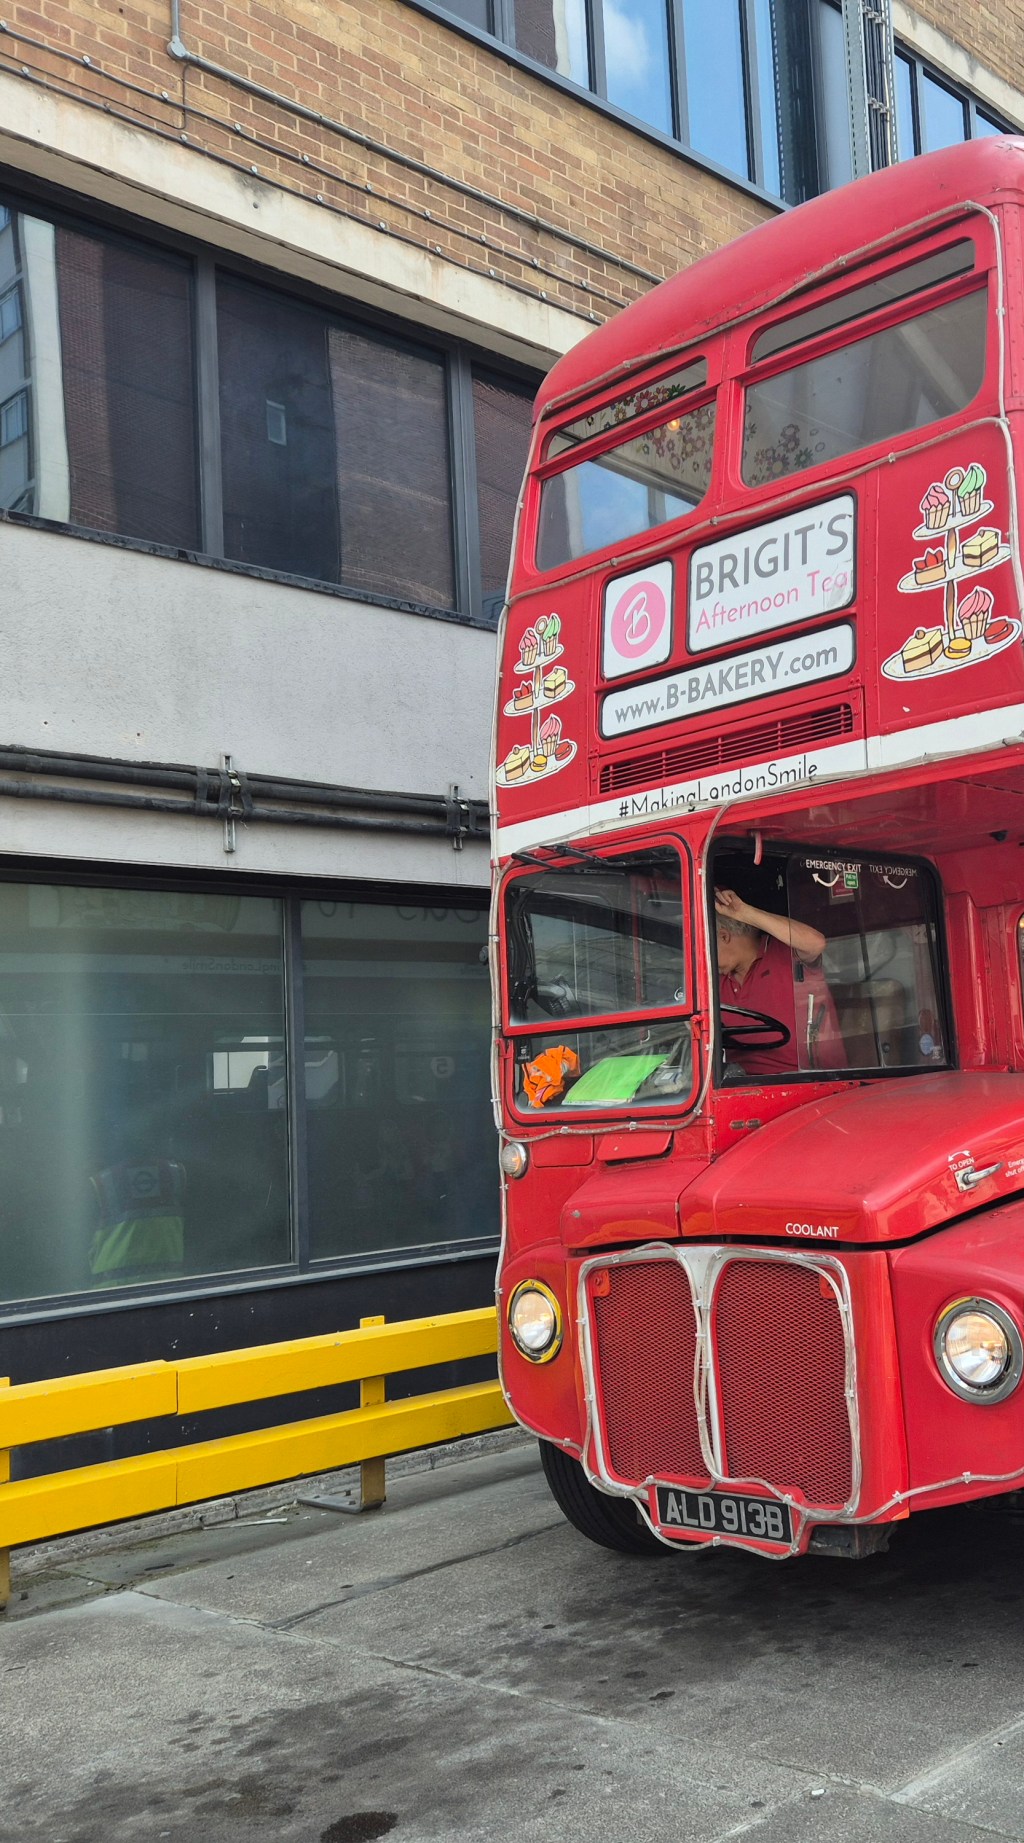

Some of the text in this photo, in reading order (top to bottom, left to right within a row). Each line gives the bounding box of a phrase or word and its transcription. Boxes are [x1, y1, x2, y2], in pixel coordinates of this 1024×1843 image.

[695, 513, 849, 601] BRIGIT'S
[695, 570, 849, 634] Afternoon Tea
[614, 646, 838, 724] www.B-BAKERY.com
[805, 859, 862, 873] EMERGENCY EXIT
[949, 1157, 975, 1172] TO OPEN
[785, 1222, 840, 1238] COOLANT
[665, 1491, 784, 1539] ALD 913B
